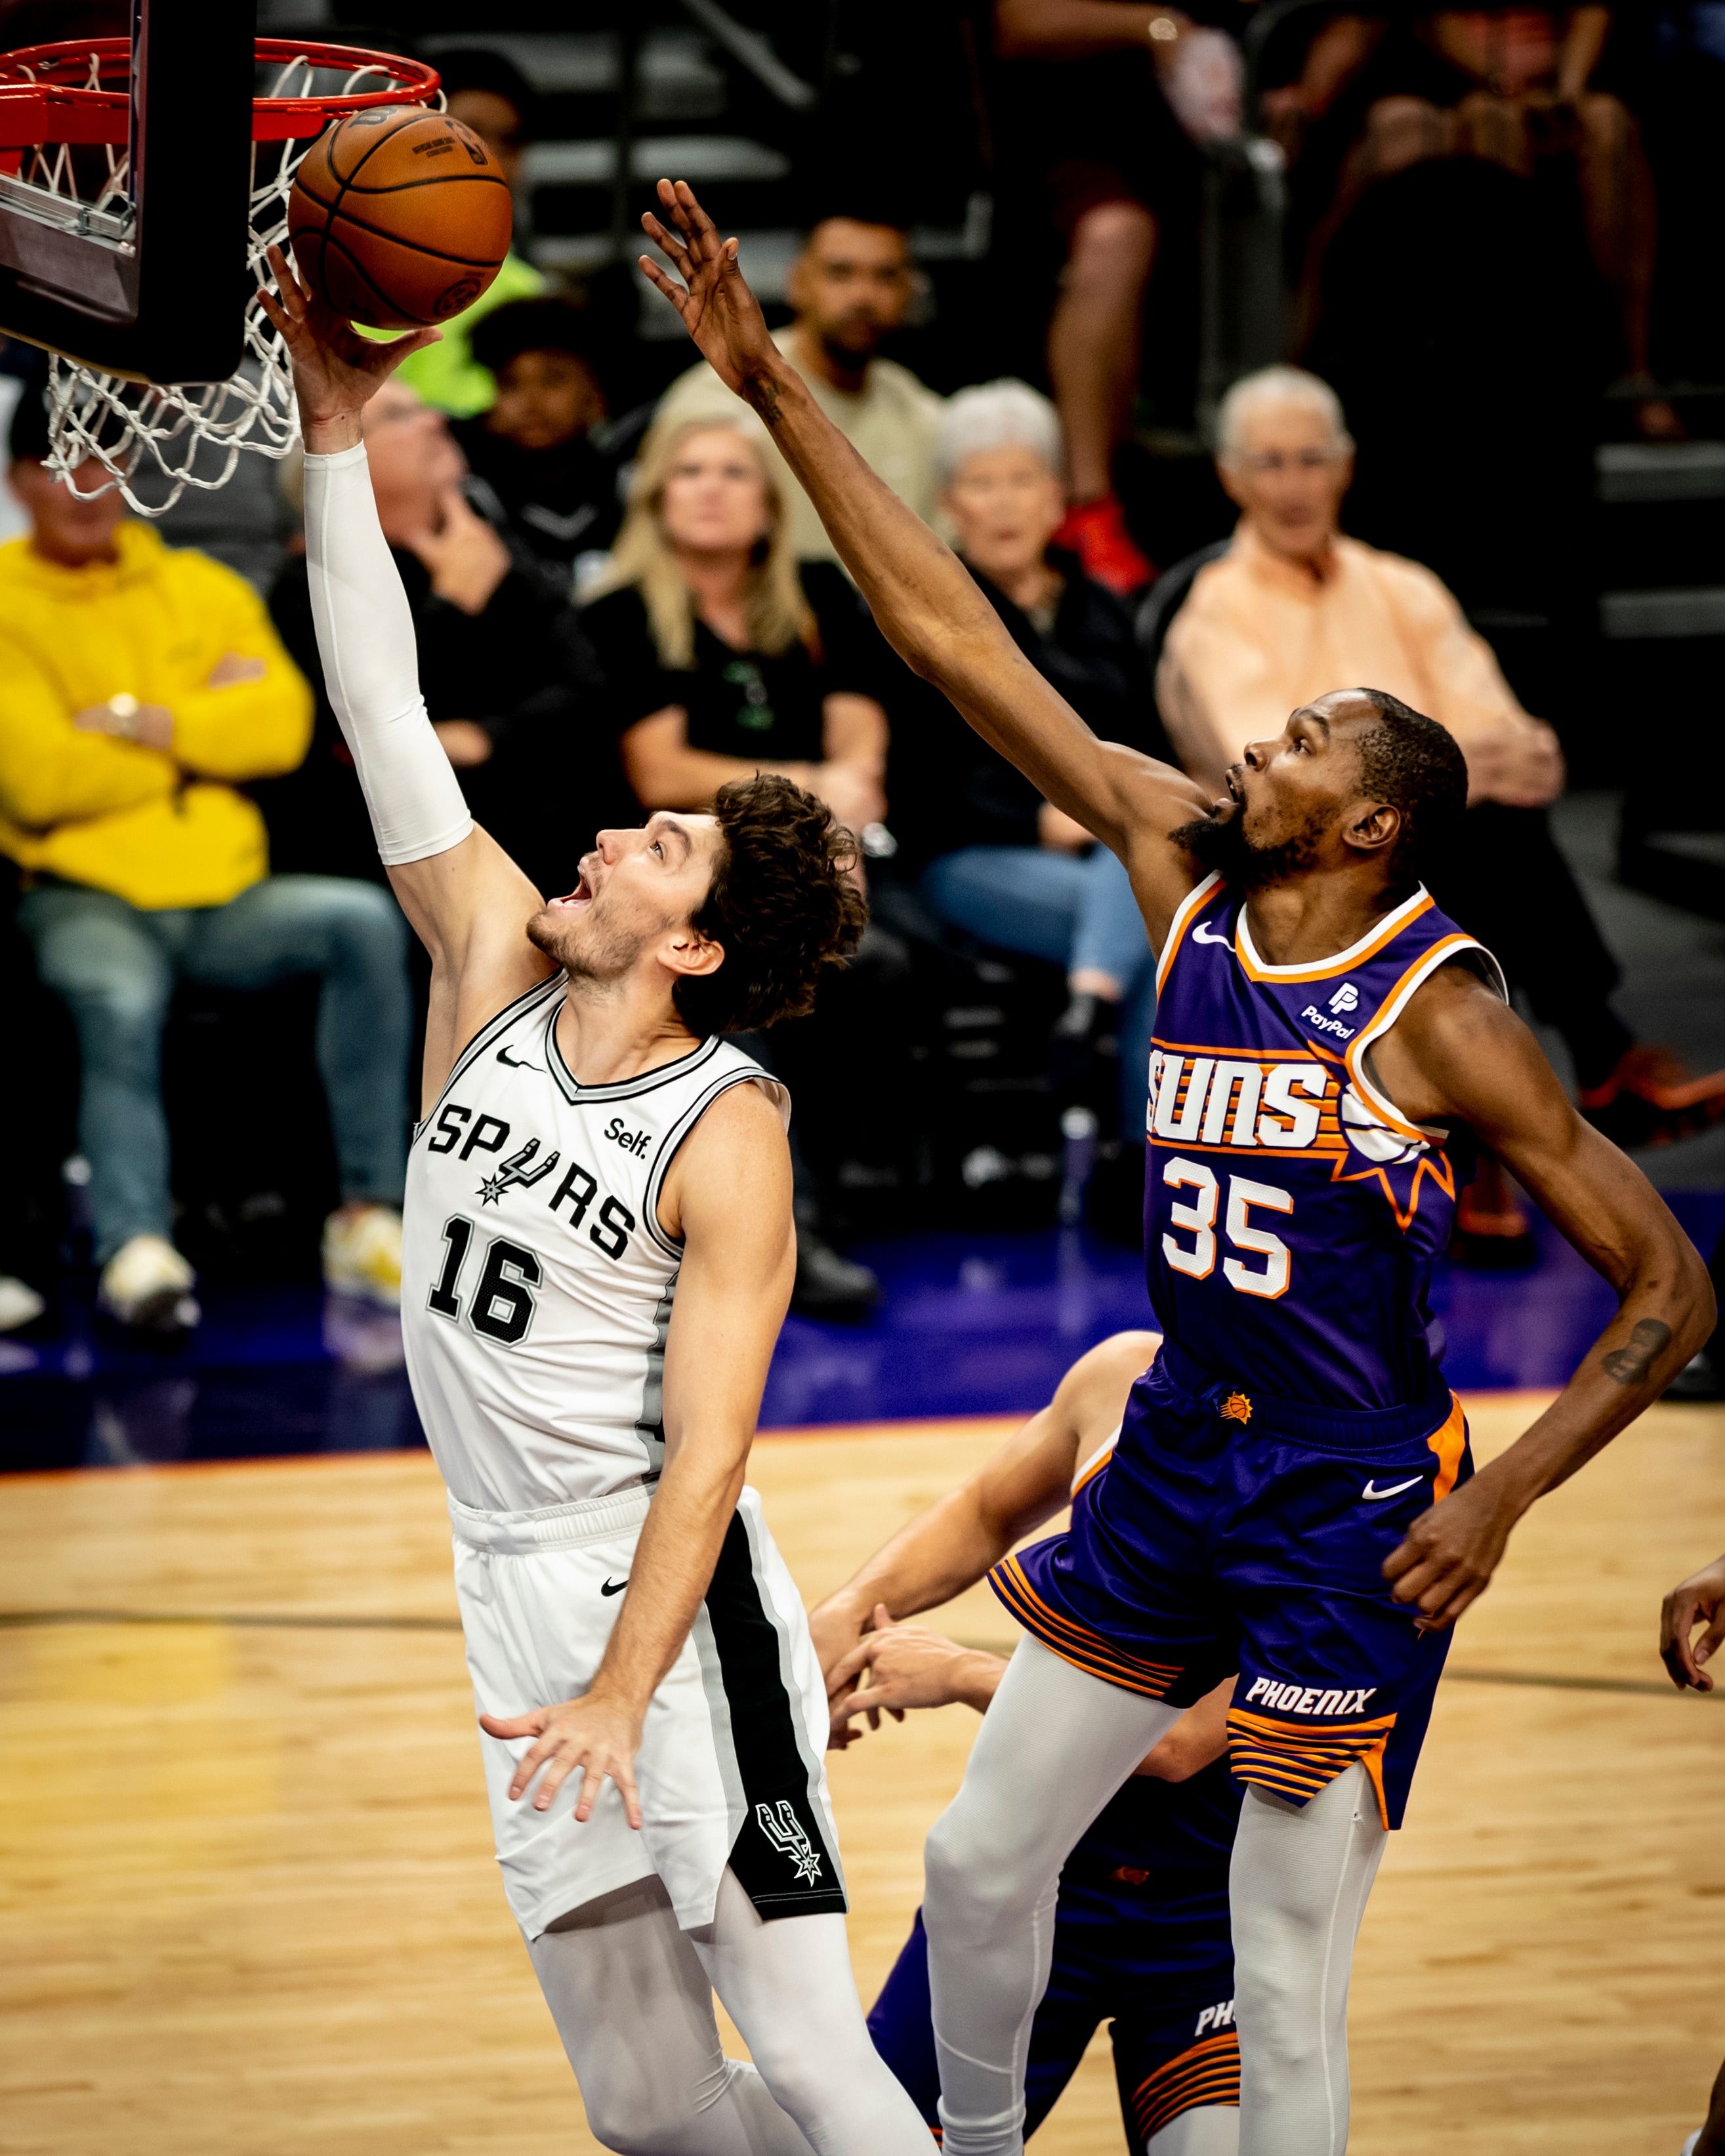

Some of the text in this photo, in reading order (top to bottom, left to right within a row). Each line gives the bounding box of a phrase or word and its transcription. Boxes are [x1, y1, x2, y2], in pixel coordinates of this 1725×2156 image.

[1300, 1005, 1356, 1039] PayPal
[1146, 1049, 1327, 1148] SUNS
[604, 1117, 652, 1160] Self.
[427, 1103, 636, 1261] SPURS
[1162, 1156, 1294, 1300] 35
[425, 1213, 544, 1349] 16
[1245, 1676, 1377, 1716] PHOENIX
[1194, 1999, 1236, 2037] PH
